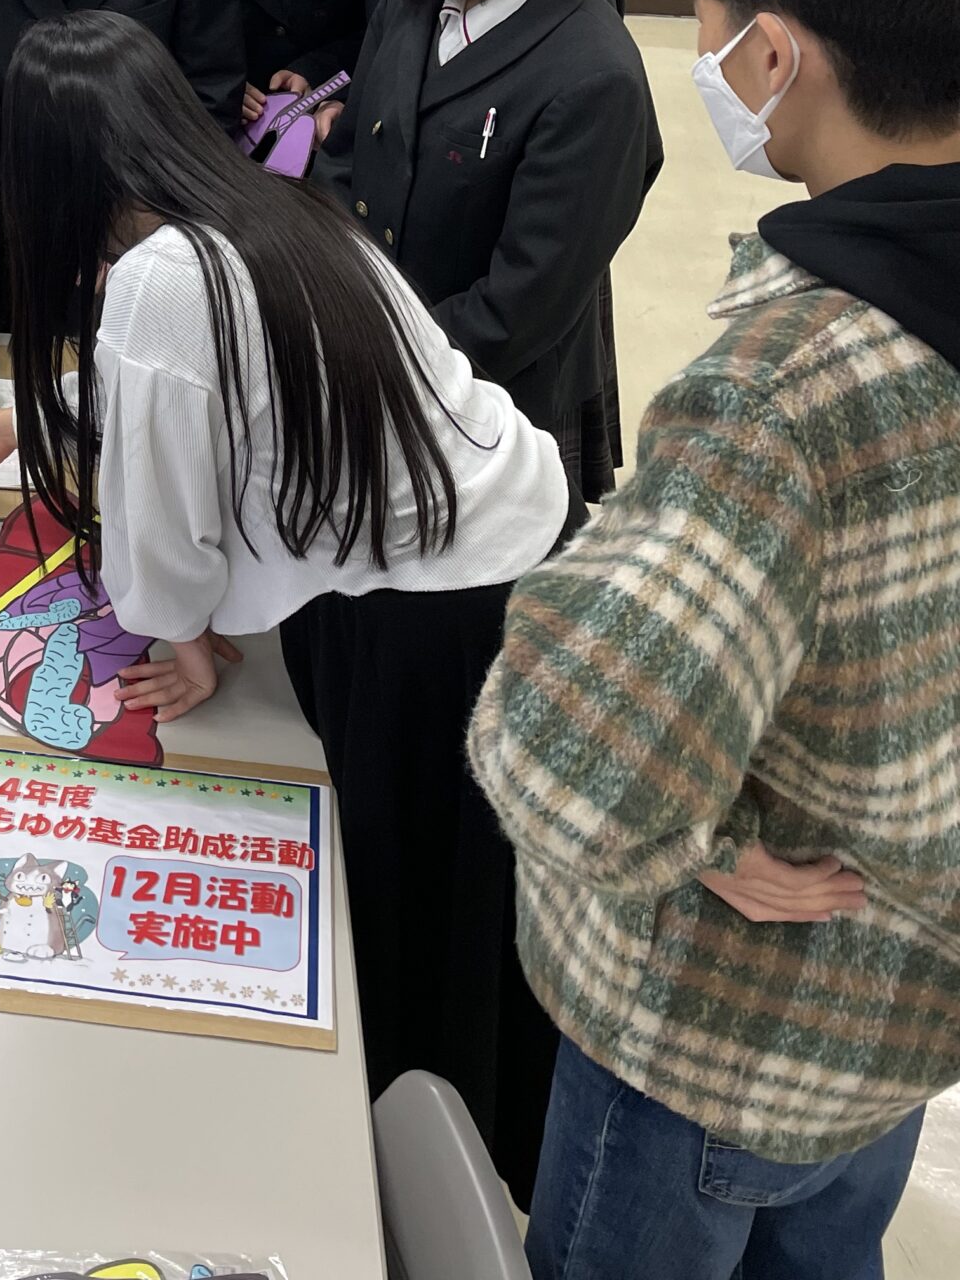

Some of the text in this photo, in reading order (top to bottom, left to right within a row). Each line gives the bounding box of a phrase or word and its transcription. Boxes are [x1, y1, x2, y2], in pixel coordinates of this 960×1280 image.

[110, 865, 295, 919] 12月活動
[126, 910, 262, 956] 実施中
